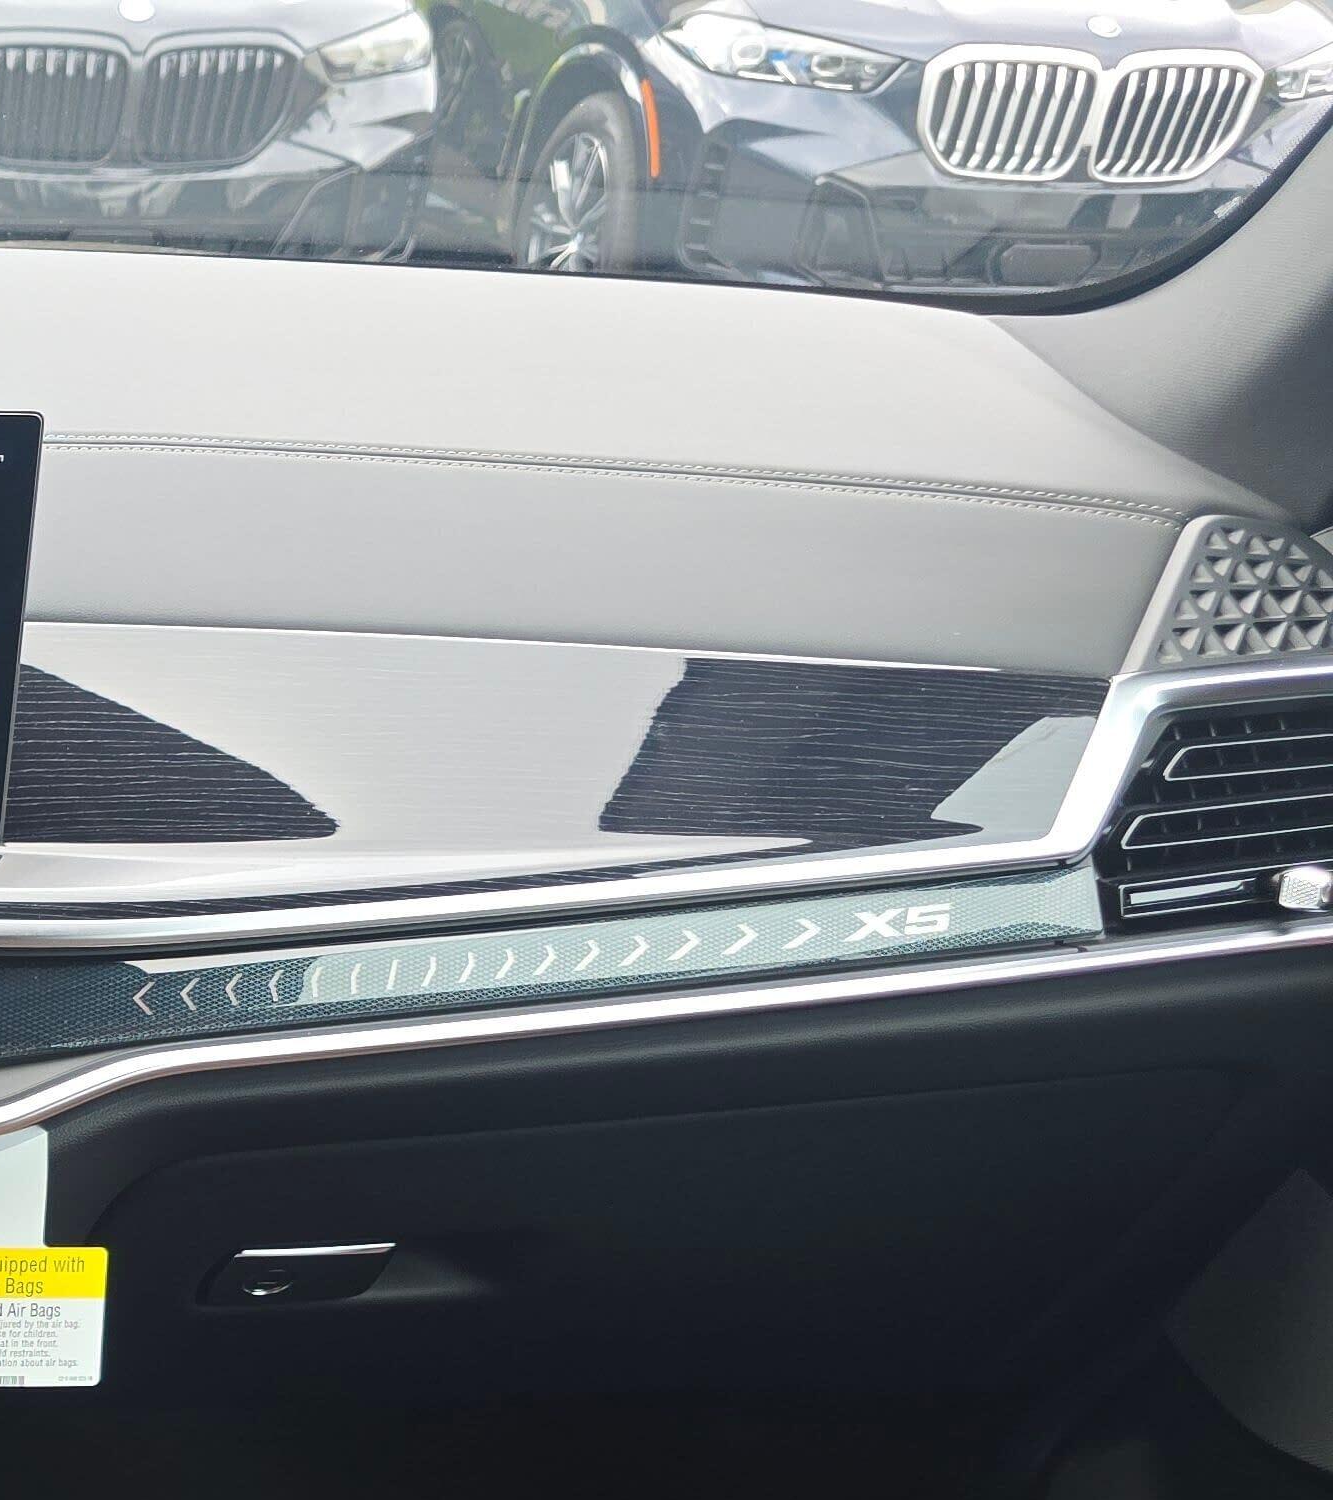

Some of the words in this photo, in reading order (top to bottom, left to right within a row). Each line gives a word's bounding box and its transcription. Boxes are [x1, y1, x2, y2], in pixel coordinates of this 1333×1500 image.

[844, 903, 951, 942] X5
[53, 1256, 85, 1273] with
[5, 1278, 44, 1297] Bags
[8, 1302, 27, 1318] Air
[30, 1303, 61, 1320] Bags
[24, 1319, 34, 1330] by
[36, 1320, 49, 1329] the
[51, 1320, 62, 1329] air
[64, 1320, 81, 1330] bag.
[8, 1329, 21, 1338] for
[23, 1329, 58, 1338] children.
[11, 1339, 19, 1348] in
[21, 1339, 34, 1348] the
[36, 1339, 58, 1348] front.
[9, 1349, 51, 1358] restraints.
[20, 1358, 43, 1367] about
[45, 1358, 56, 1367] air
[58, 1358, 78, 1369] bags.
